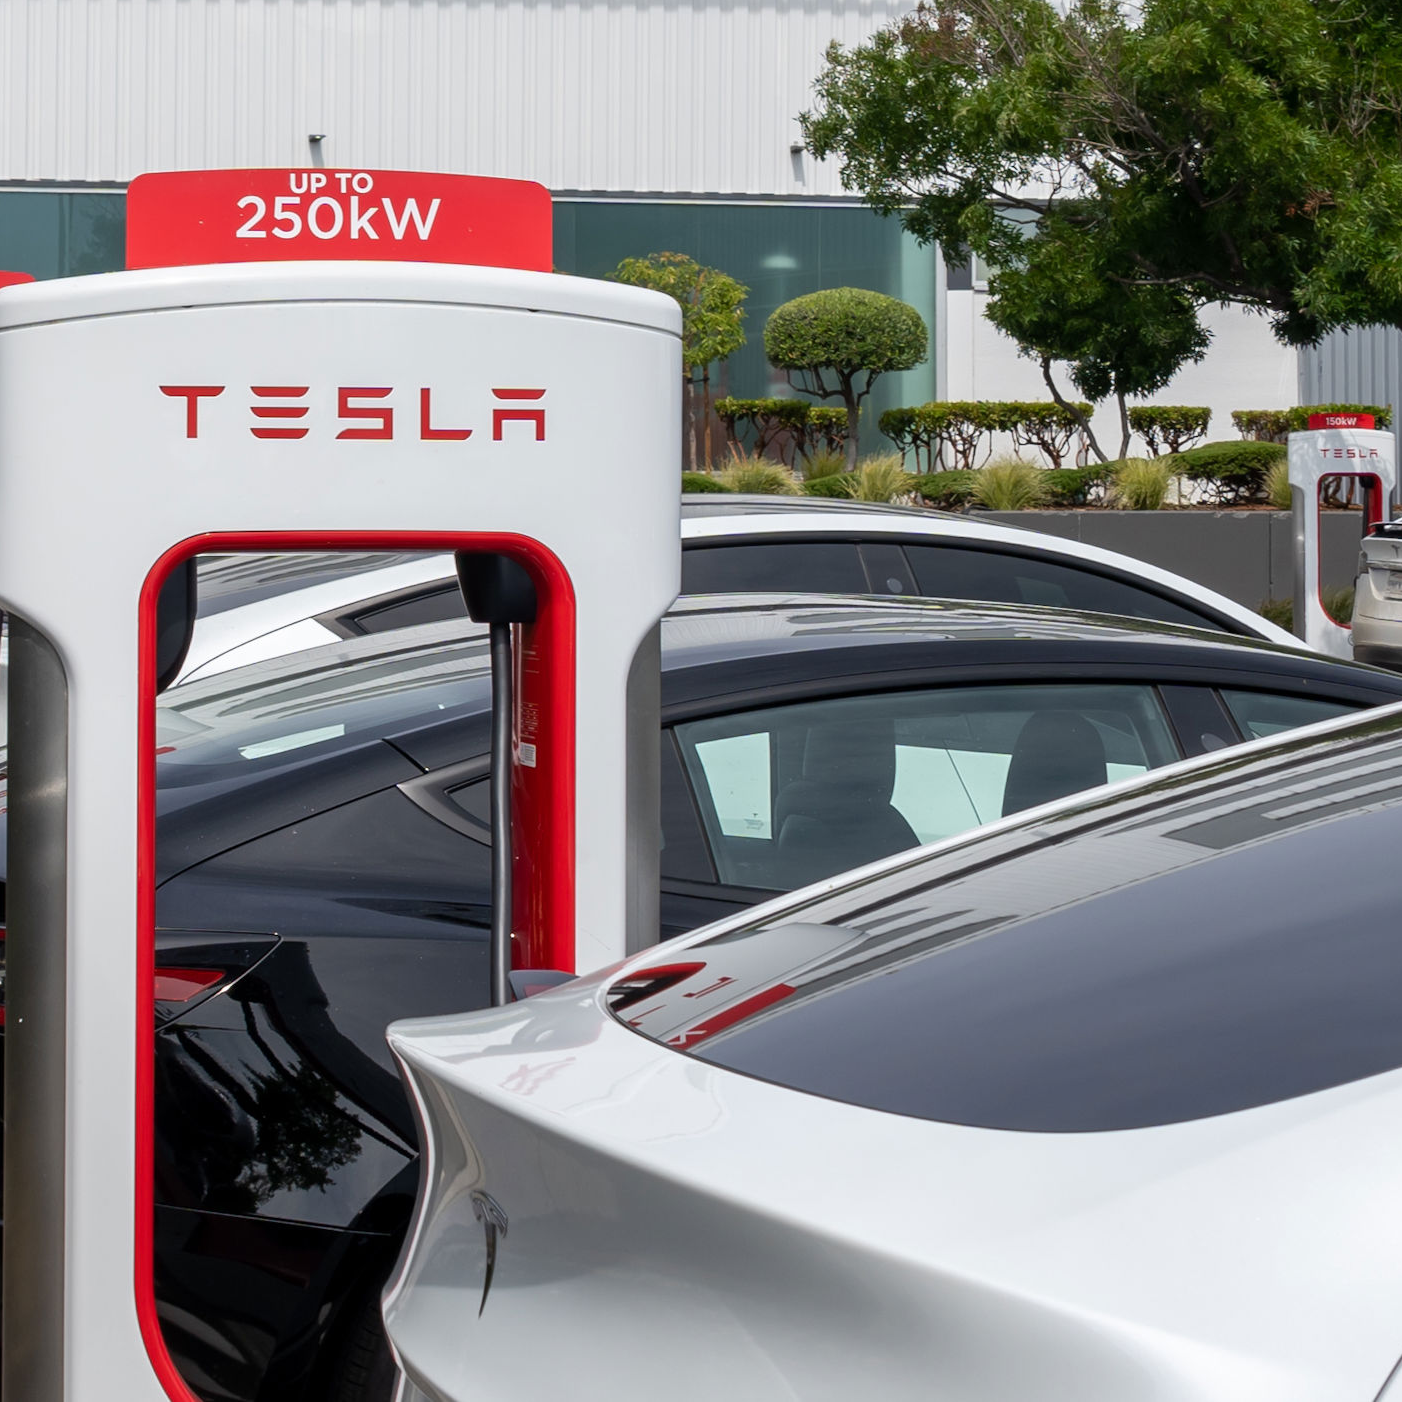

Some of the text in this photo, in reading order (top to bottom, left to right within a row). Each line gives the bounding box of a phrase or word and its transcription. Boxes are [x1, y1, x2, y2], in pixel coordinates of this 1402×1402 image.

[289, 173, 374, 194] UP TO
[236, 196, 441, 240] 250kW
[158, 384, 547, 441] TESLA
[1325, 416, 1358, 427] 150kW
[1319, 448, 1379, 459] TESLA
